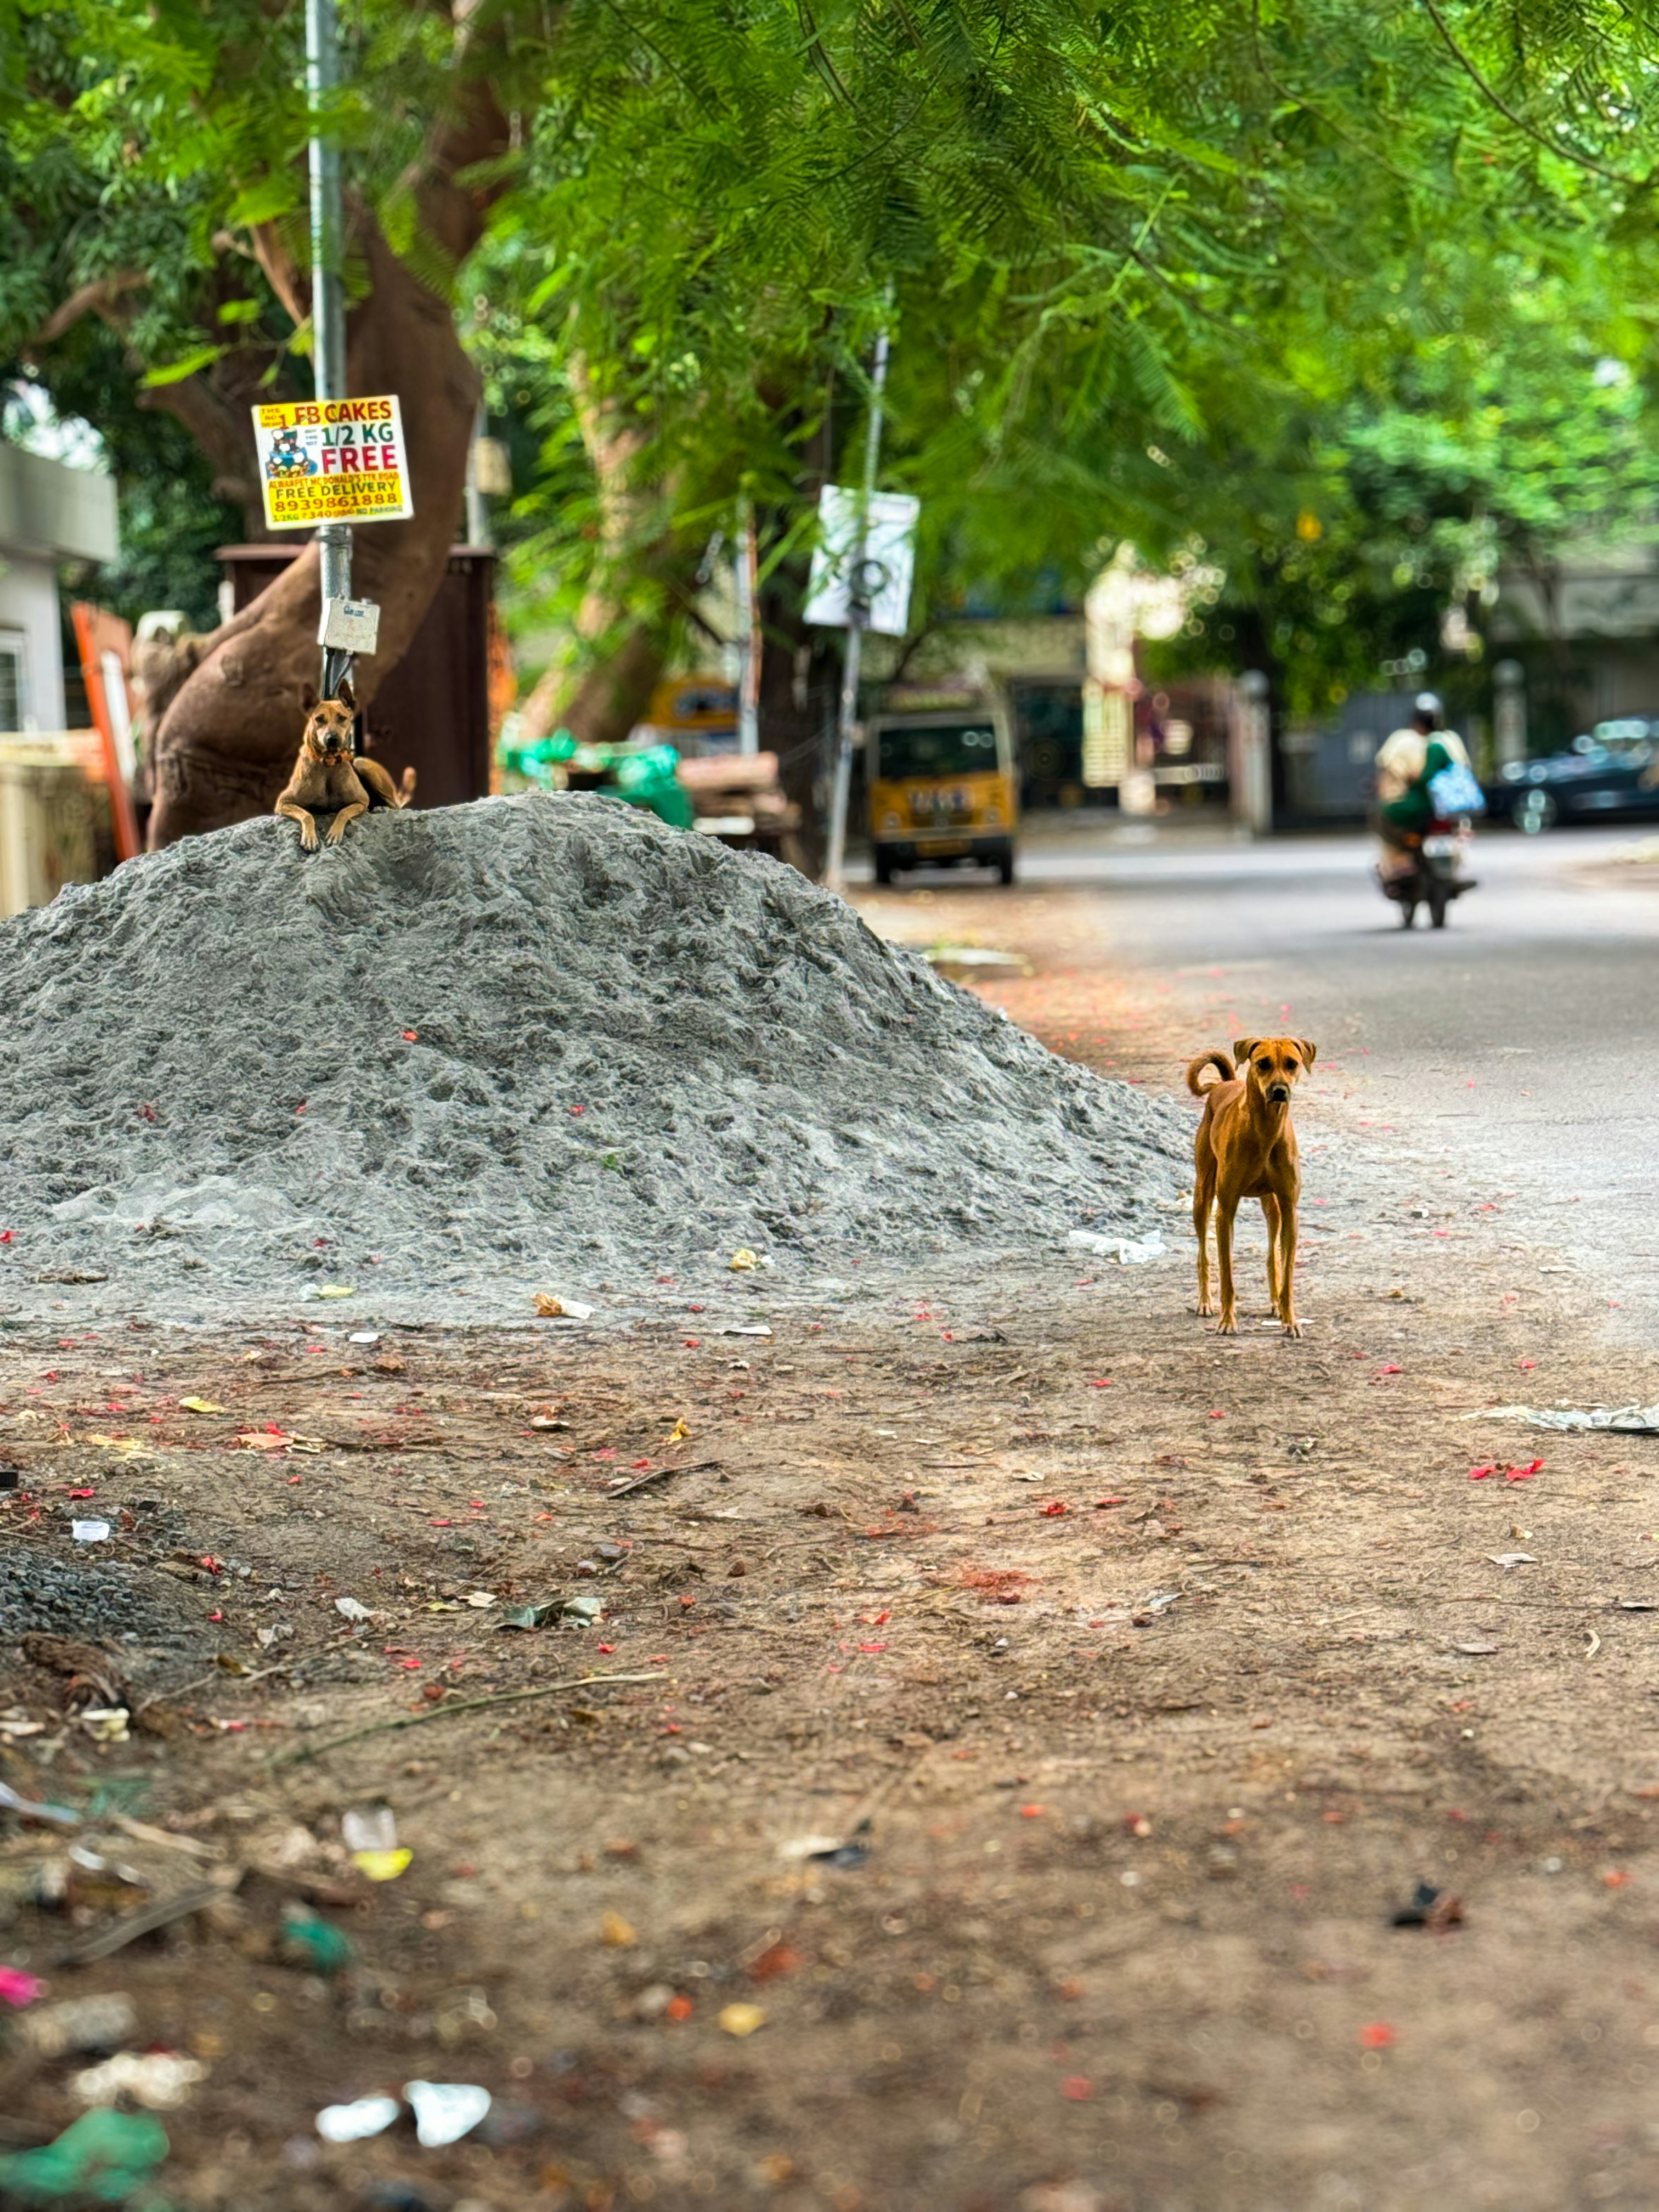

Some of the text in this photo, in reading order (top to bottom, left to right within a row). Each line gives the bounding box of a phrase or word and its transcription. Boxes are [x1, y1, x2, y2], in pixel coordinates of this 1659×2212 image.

[295, 400, 392, 425] FB CAKES
[321, 422, 394, 446] 1/2 KG
[321, 445, 398, 474] FREE
[276, 481, 396, 499] FREE DELIVERY
[275, 493, 397, 512] 8939861888
